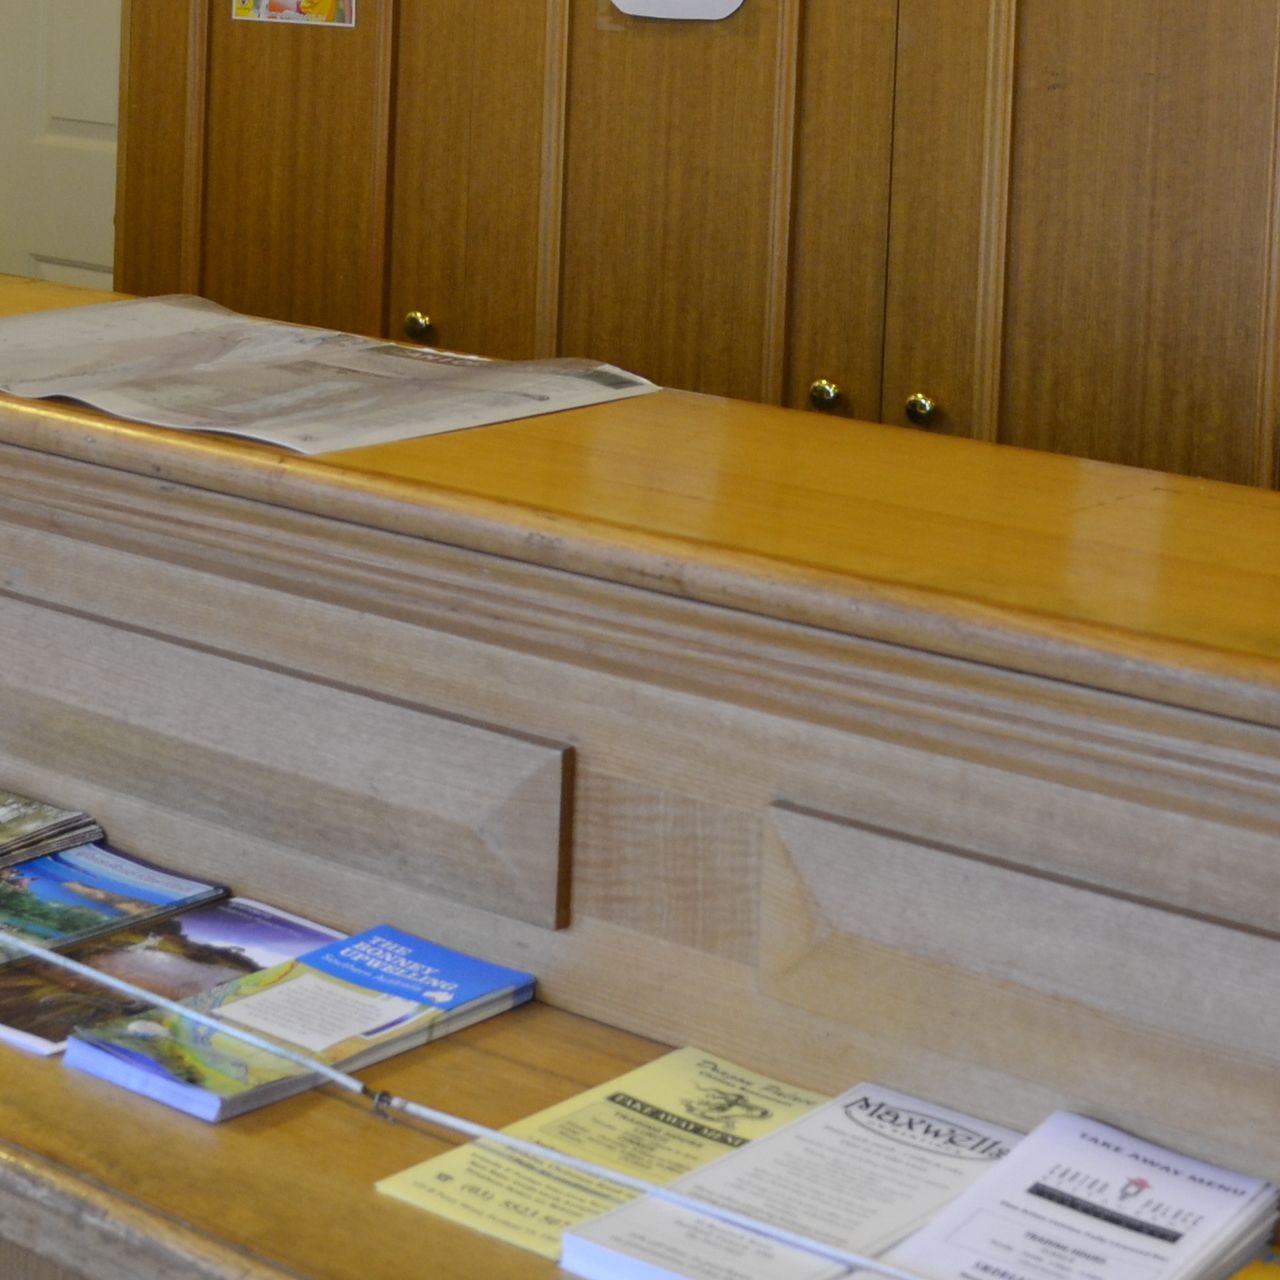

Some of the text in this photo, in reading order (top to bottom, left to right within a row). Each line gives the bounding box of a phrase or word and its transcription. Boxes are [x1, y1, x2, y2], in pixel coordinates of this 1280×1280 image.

[353, 941, 440, 974] BONNEY
[369, 936, 412, 955] THE
[321, 953, 372, 977] Southern
[340, 948, 458, 991] UPWELLING
[613, 1094, 653, 1116] TAKE
[844, 1096, 1010, 1158] Maxwells
[1078, 1131, 1248, 1197] TAKE AWAY MENU
